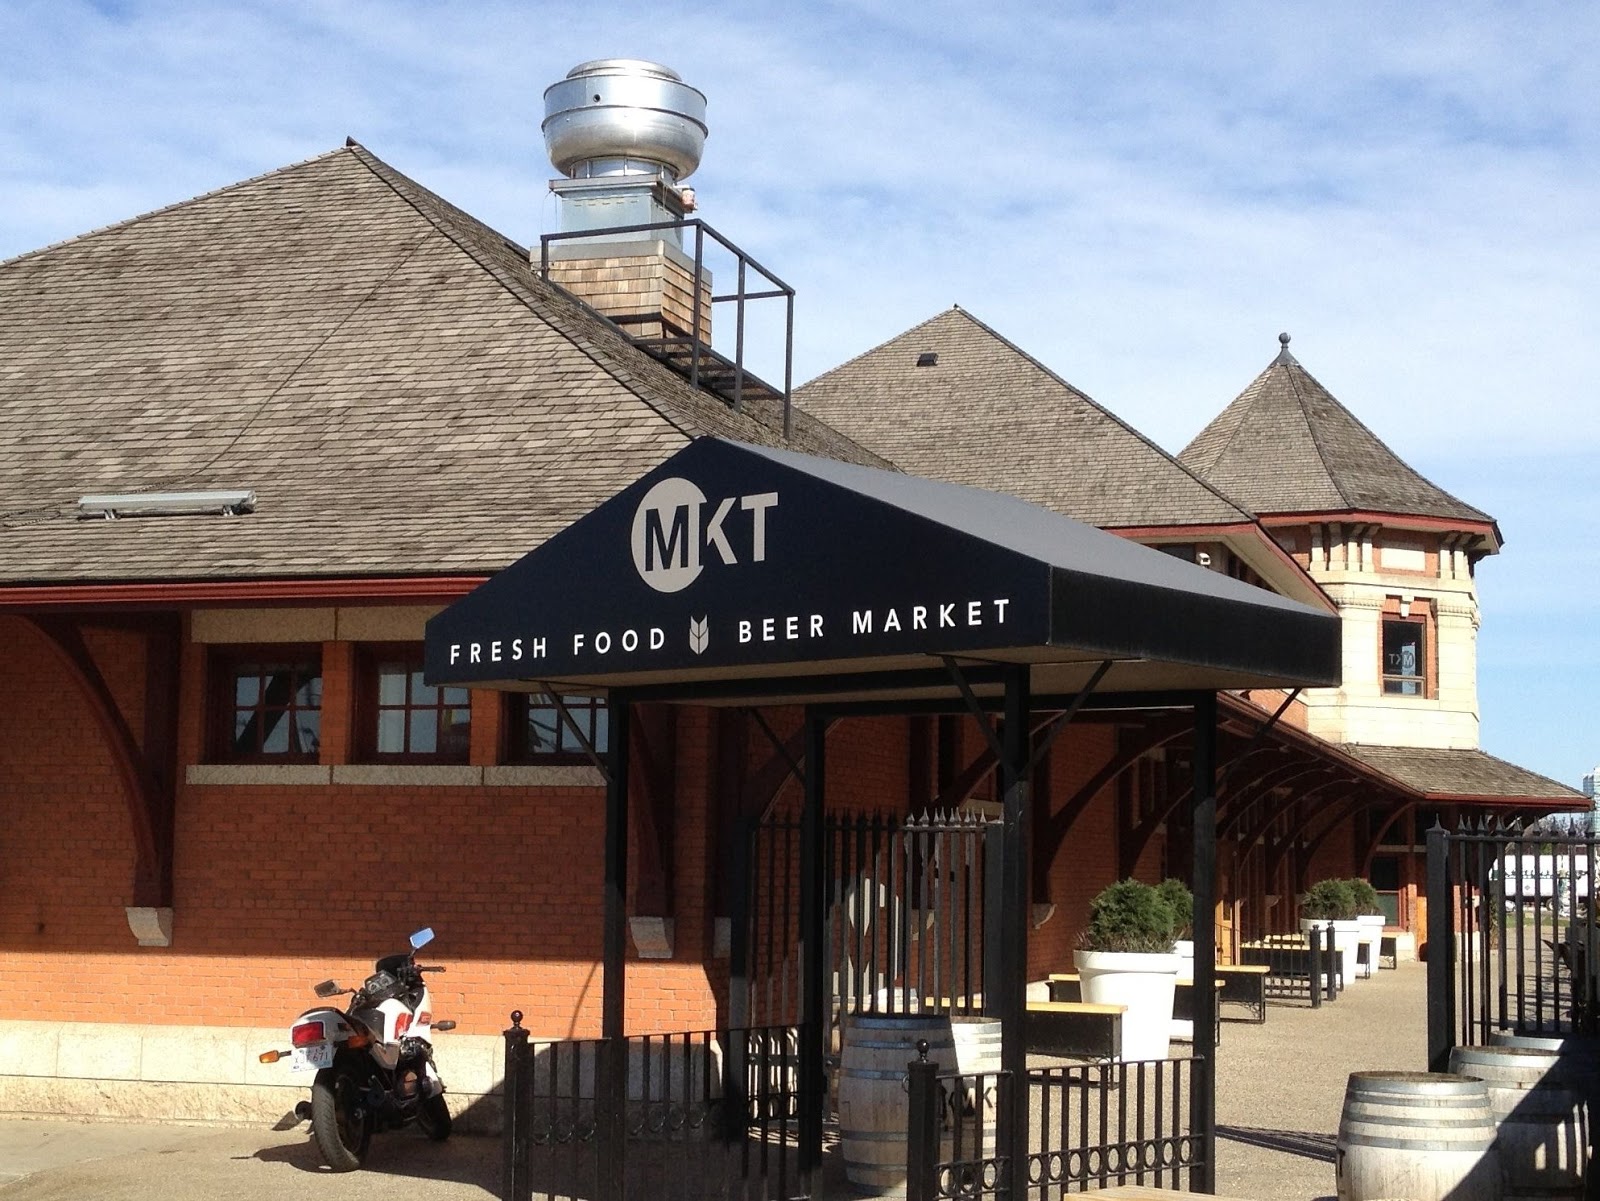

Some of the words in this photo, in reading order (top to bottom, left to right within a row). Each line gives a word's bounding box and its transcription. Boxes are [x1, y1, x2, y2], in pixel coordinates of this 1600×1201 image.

[641, 490, 779, 574] MKT
[450, 637, 547, 666] FRESH
[573, 627, 666, 656] FOOD
[738, 614, 825, 644] BEER
[852, 598, 1011, 635] MARKET
